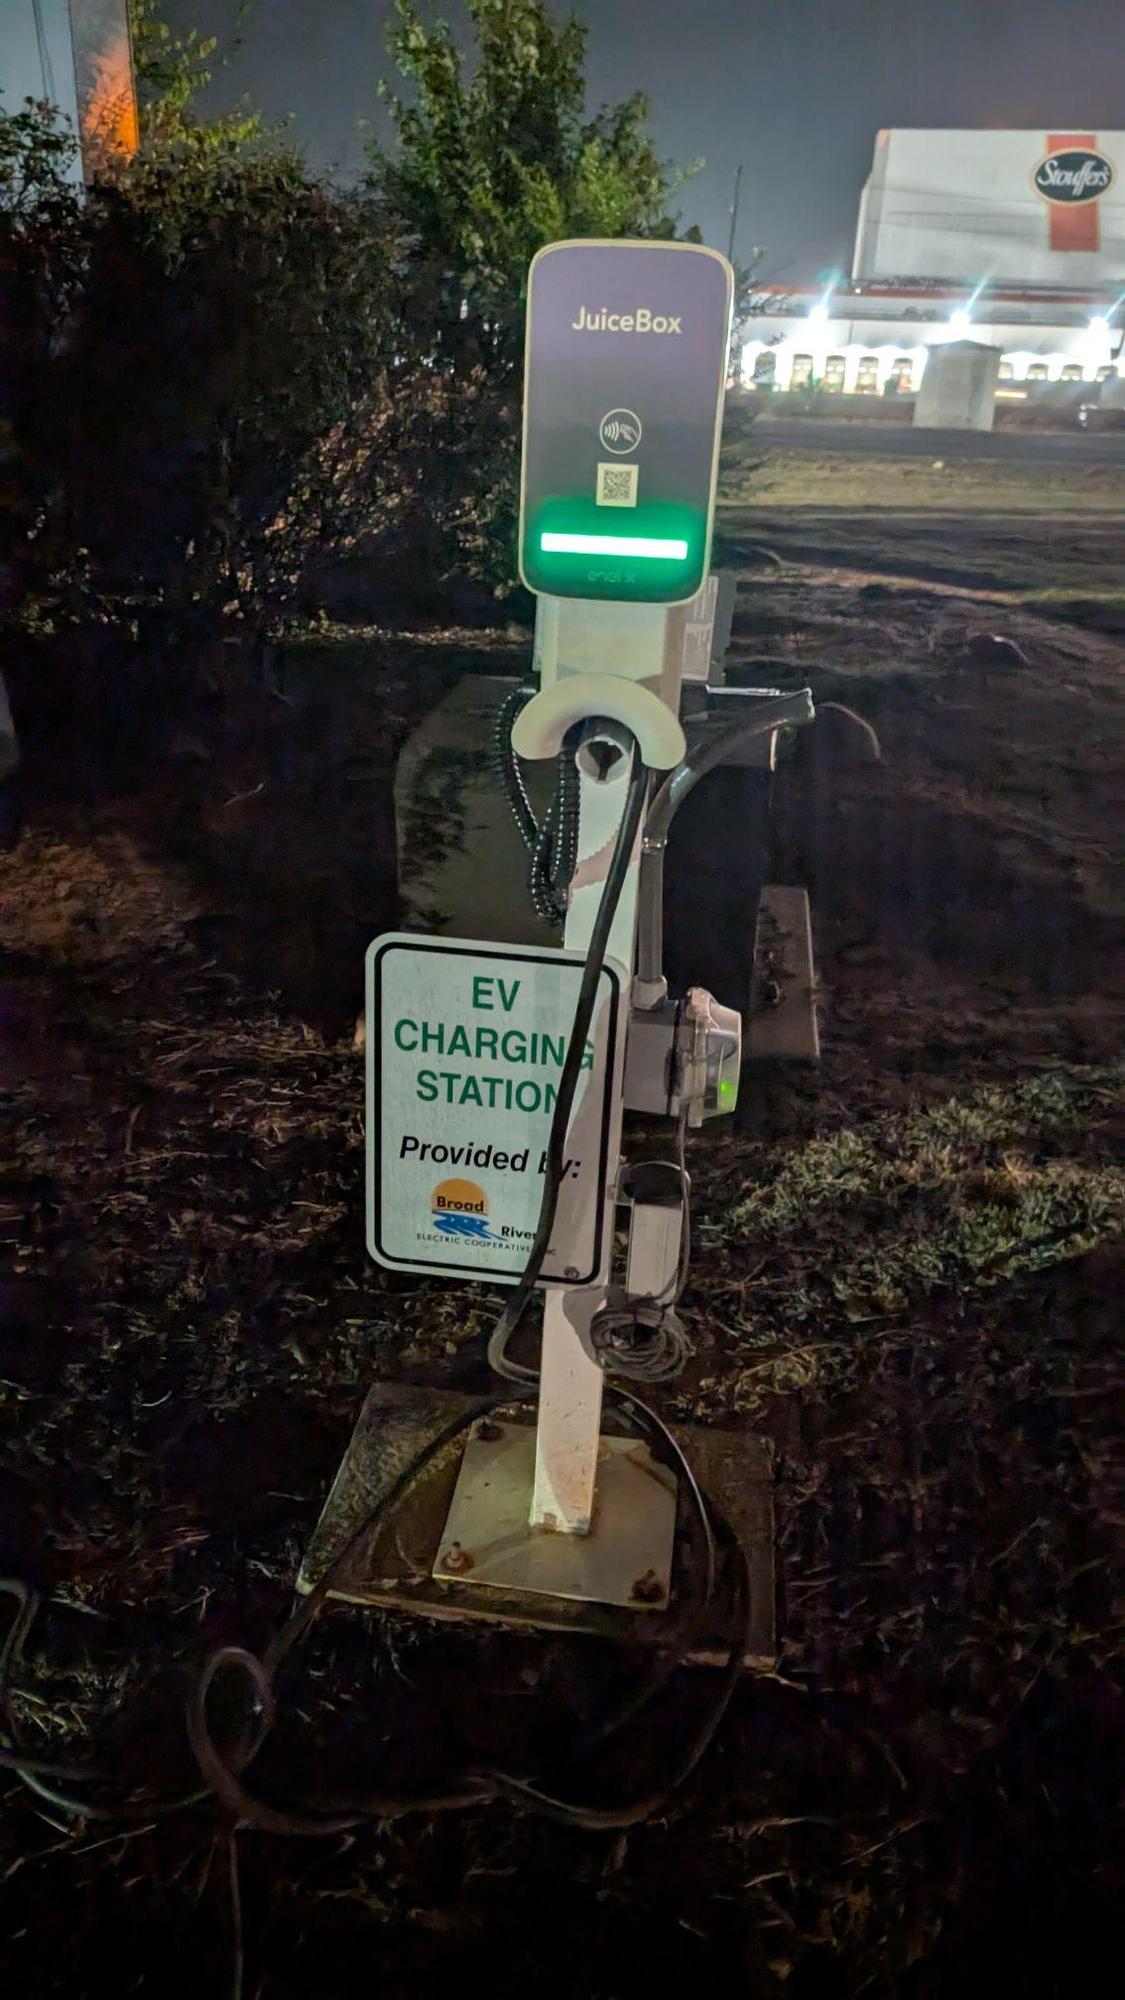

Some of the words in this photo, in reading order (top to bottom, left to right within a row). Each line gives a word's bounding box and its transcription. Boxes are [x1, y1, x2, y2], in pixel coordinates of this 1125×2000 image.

[571, 306, 683, 334] JuiceBox
[471, 976, 521, 1012] EV
[399, 1135, 530, 1173] Provided
[436, 1195, 484, 1212] Broad
[416, 1232, 461, 1245] ELECTRIC
